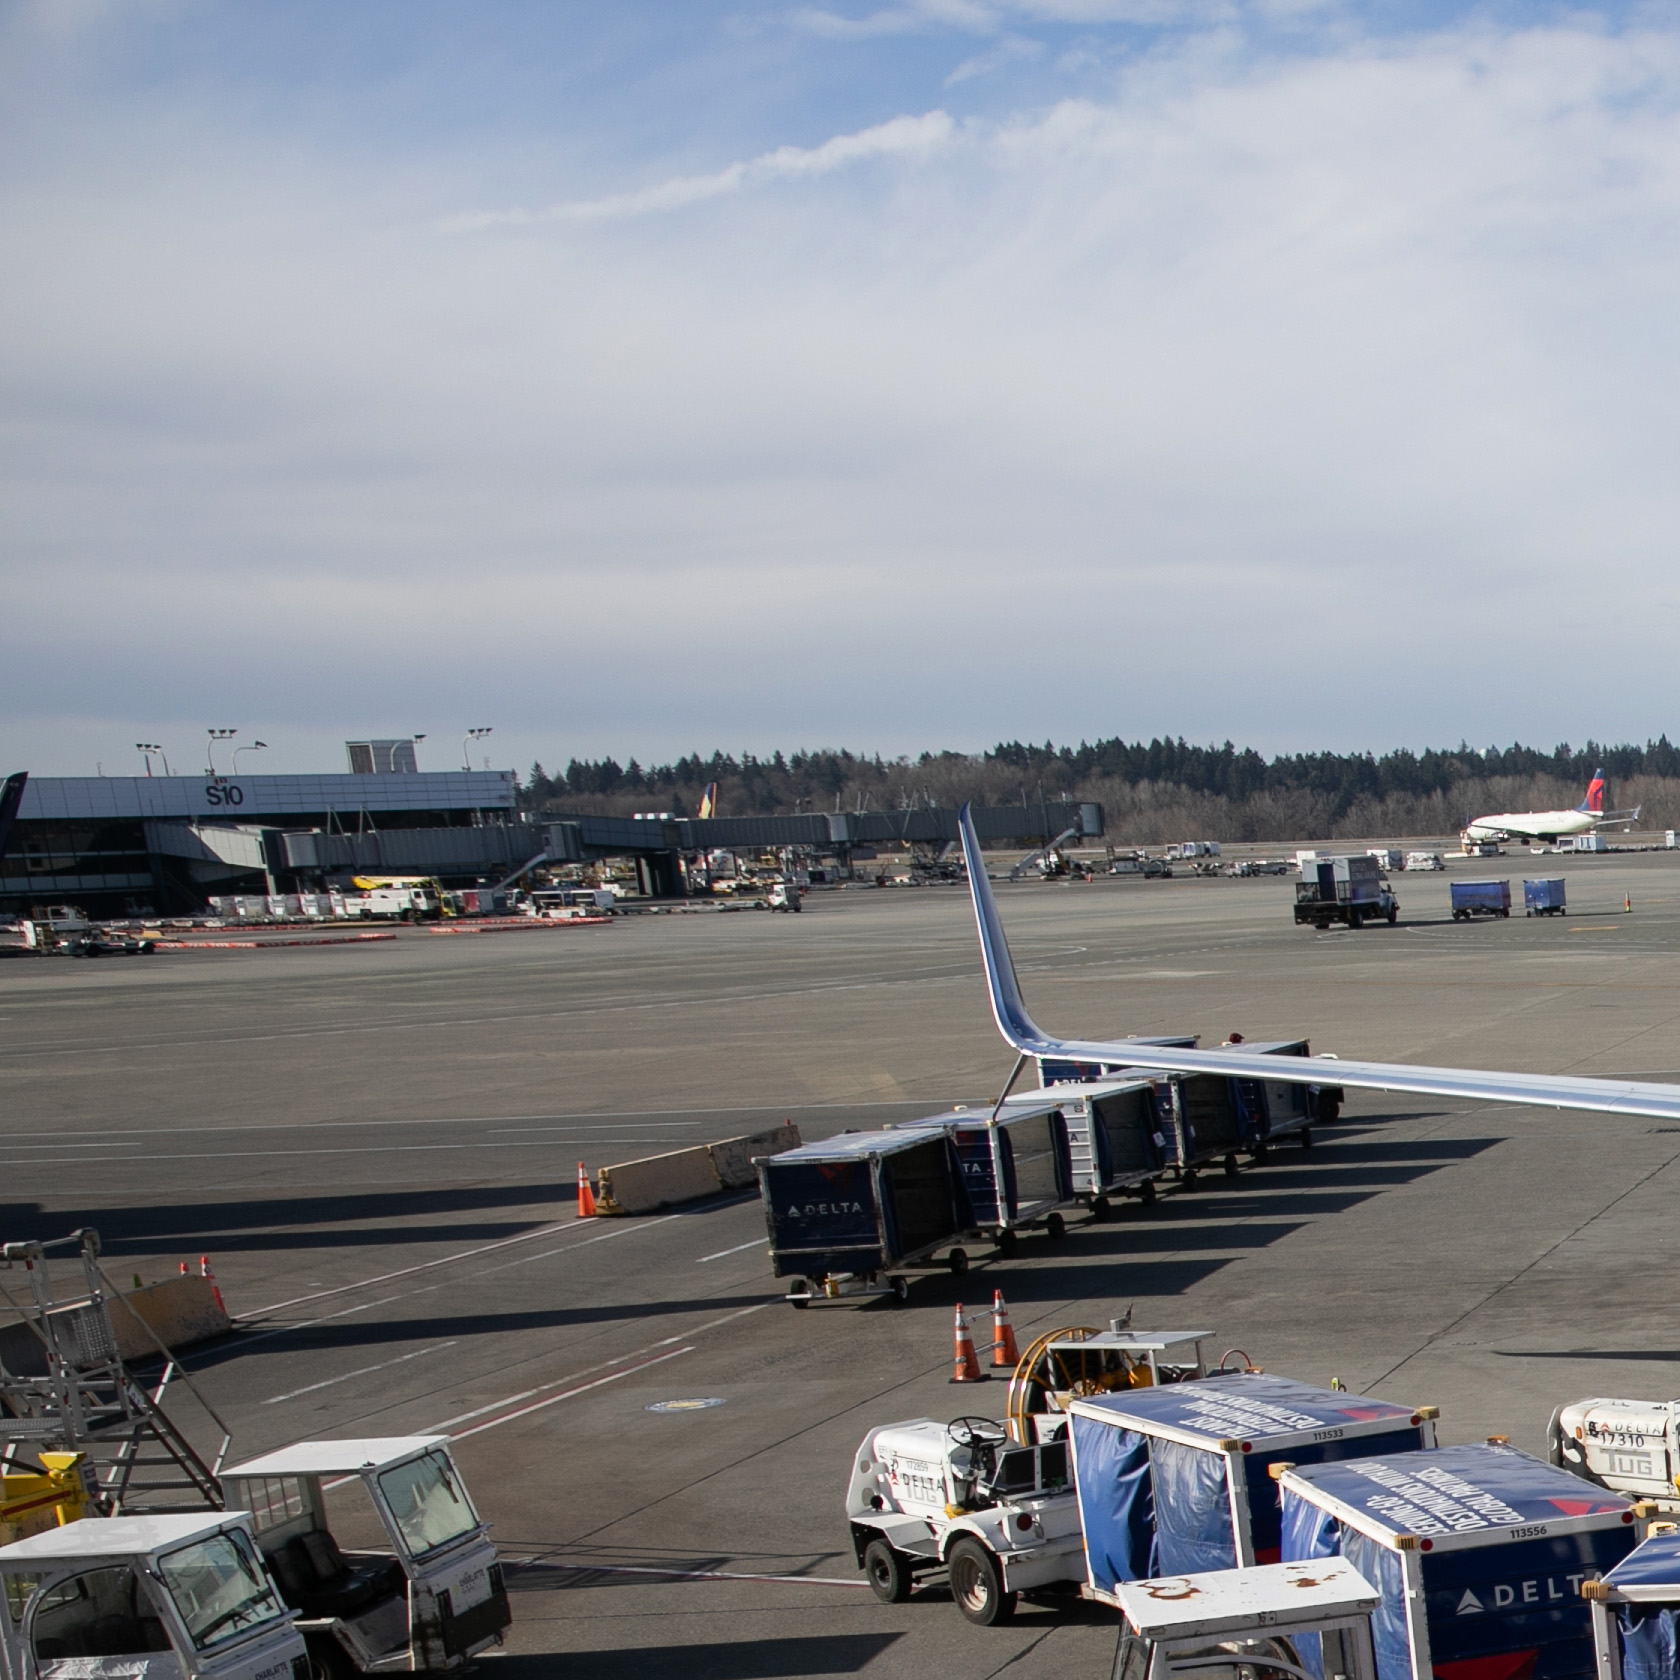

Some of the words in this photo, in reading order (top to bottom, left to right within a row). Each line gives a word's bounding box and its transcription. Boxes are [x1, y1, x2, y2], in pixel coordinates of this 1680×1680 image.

[205, 785, 244, 806] S10
[804, 1201, 864, 1217] DELTA
[1312, 1429, 1344, 1441] 113533
[1615, 1422, 1662, 1435] DELTA
[1599, 1448, 1655, 1476] TUG
[902, 1473, 946, 1492] DELTA
[1389, 1482, 1489, 1530] DESTINATIONS
[1459, 1493, 1527, 1523] GLOBAL
[1379, 1504, 1450, 1535] SERVING
[1509, 1526, 1548, 1539] 113556
